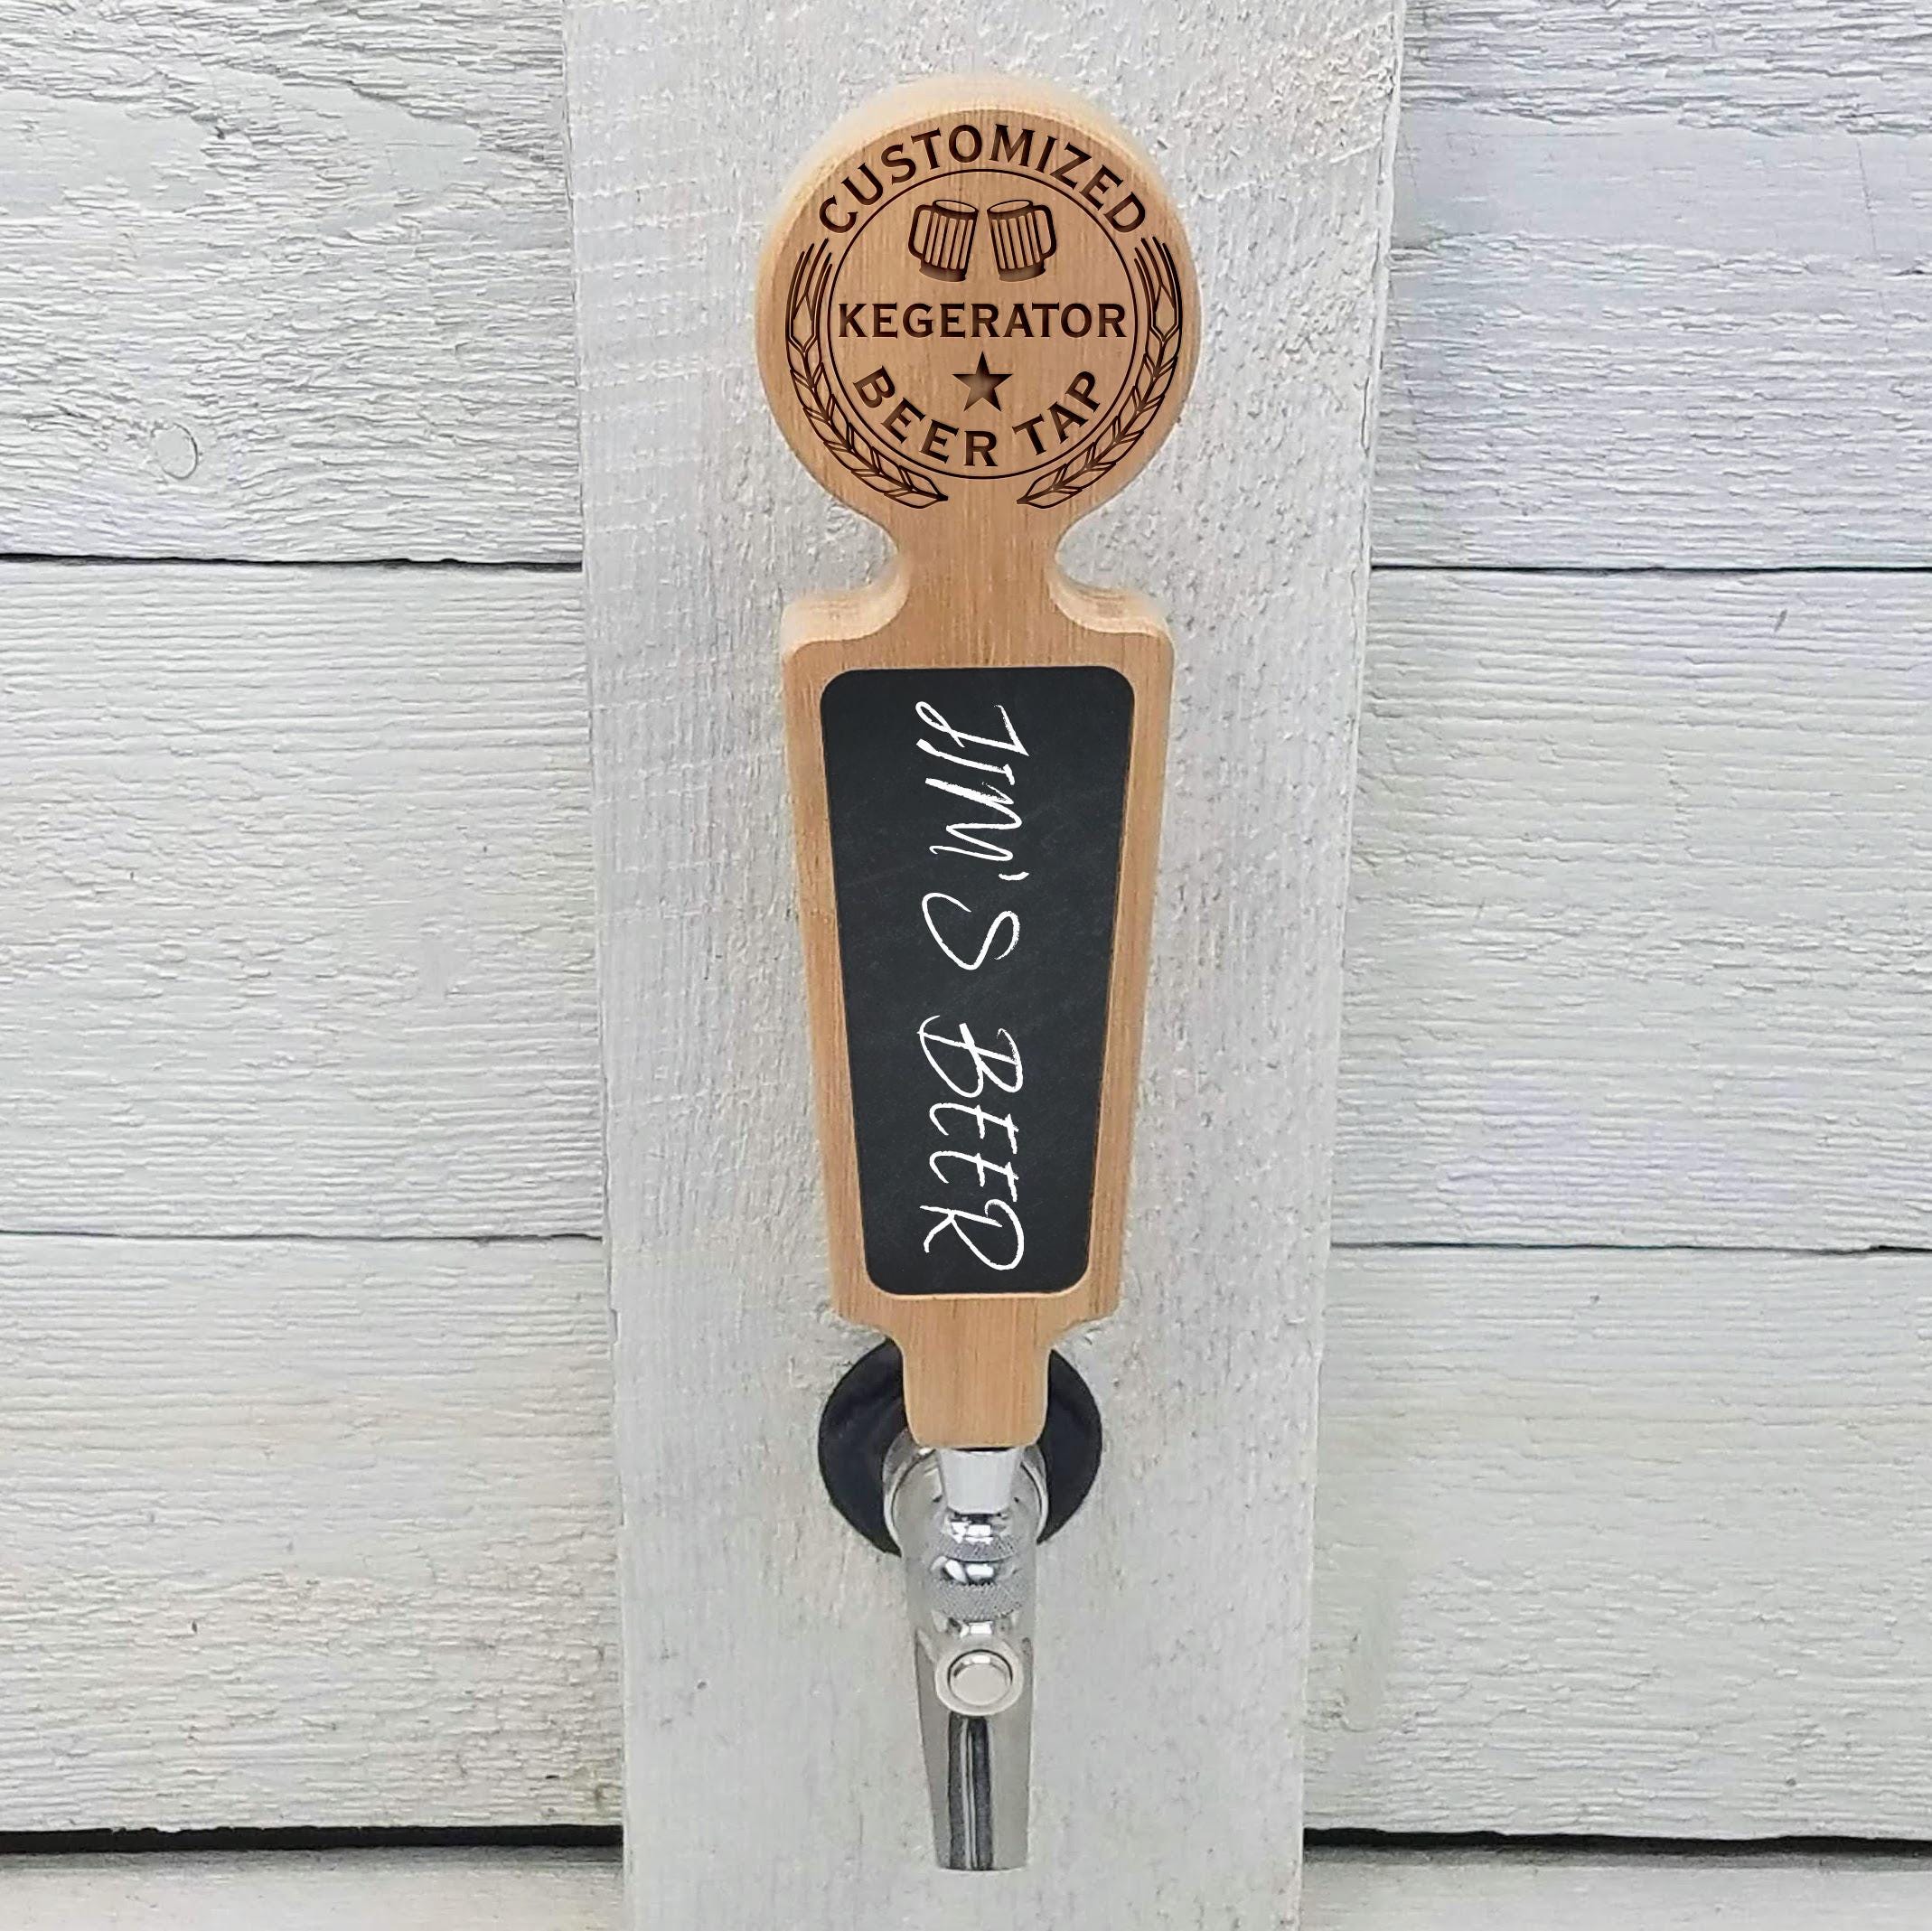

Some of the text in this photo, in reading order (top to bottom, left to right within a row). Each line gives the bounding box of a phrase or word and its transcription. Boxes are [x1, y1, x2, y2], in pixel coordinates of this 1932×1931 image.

[819, 124, 1146, 233] CUSTOMIZED
[838, 302, 1127, 338] KEGERATOR
[853, 365, 1100, 467] BEER TAP
[914, 701, 1029, 1271] JIM'S BEER
